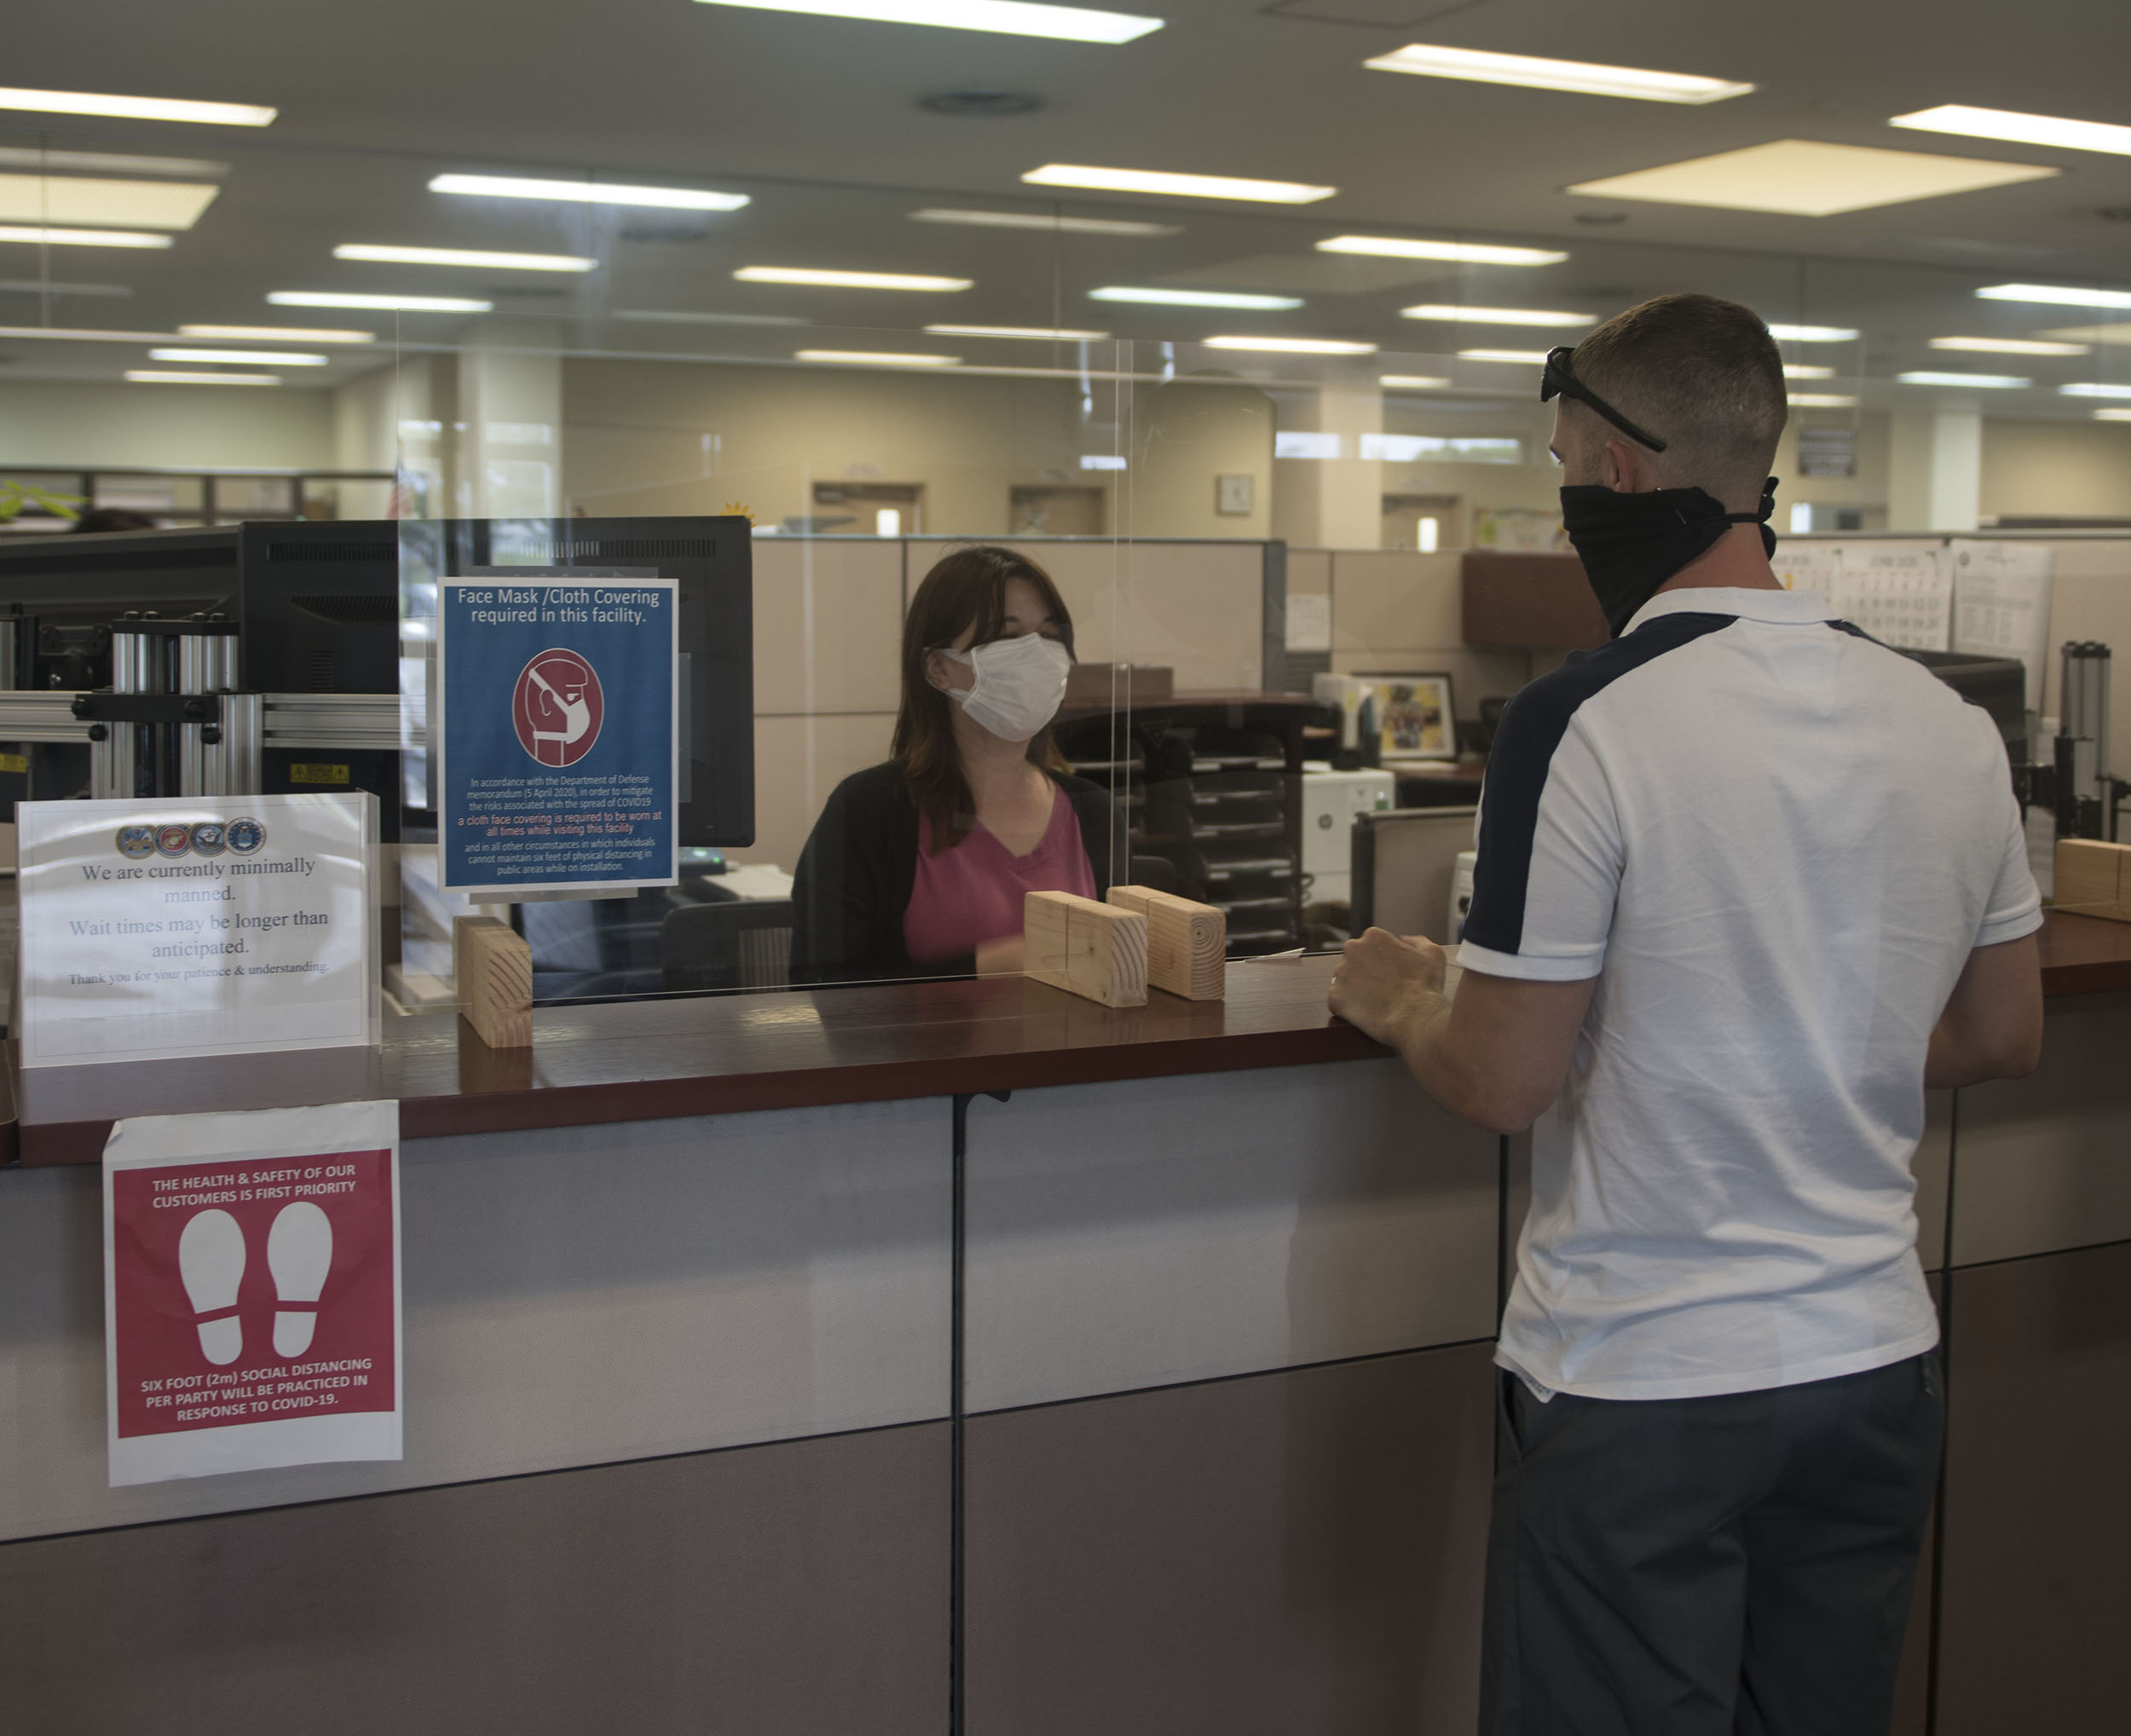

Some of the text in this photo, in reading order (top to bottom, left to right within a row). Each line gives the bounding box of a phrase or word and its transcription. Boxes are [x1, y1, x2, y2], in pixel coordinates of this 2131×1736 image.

[458, 588, 494, 603] Face
[498, 587, 539, 603] Mask
[594, 589, 660, 608] Covering
[471, 607, 646, 626] required in this facility.
[471, 774, 650, 787] In accordance with the Department of Defense
[466, 789, 523, 799] memorandum
[533, 787, 552, 799] April
[580, 787, 587, 796] in
[589, 787, 610, 796] order
[612, 787, 621, 795] to
[621, 787, 654, 797] mitigate
[469, 797, 651, 811] the risks associated with the spread of COVID19
[458, 817, 465, 826] a
[466, 815, 488, 826] cloth
[491, 814, 511, 825] face
[513, 813, 552, 826] covering
[554, 813, 563, 822] is
[564, 811, 602, 823] required
[604, 810, 614, 822] to
[615, 810, 627, 821] be
[652, 810, 662, 821] at
[487, 822, 634, 836] all times while visiting this facility
[465, 838, 655, 852] and in all other circumstances in which individuals
[467, 850, 653, 863] cannot maintain six feet of physical distancing in
[82, 857, 315, 880] We are currently minimally
[497, 865, 521, 876] public
[546, 863, 567, 873] while
[580, 862, 625, 871] installation.
[165, 885, 236, 903] manned.
[69, 910, 328, 936] Wait times may be longer than
[152, 938, 249, 960] anticipated.
[68, 961, 330, 985] Thank you for your patience & understanding.
[153, 1164, 355, 1191] THE HEALTH & SAFETY OF OUR
[153, 1180, 356, 1208] CUSTOMERS IS FIRST PRIORITY
[141, 1358, 372, 1392] SIX FOOT (2m) SOCIAL DISTANCING
[146, 1375, 368, 1408] PER PARTY WILL BE PRACTICED IN
[176, 1393, 339, 1422] RESPONSE TO COVID-19.
